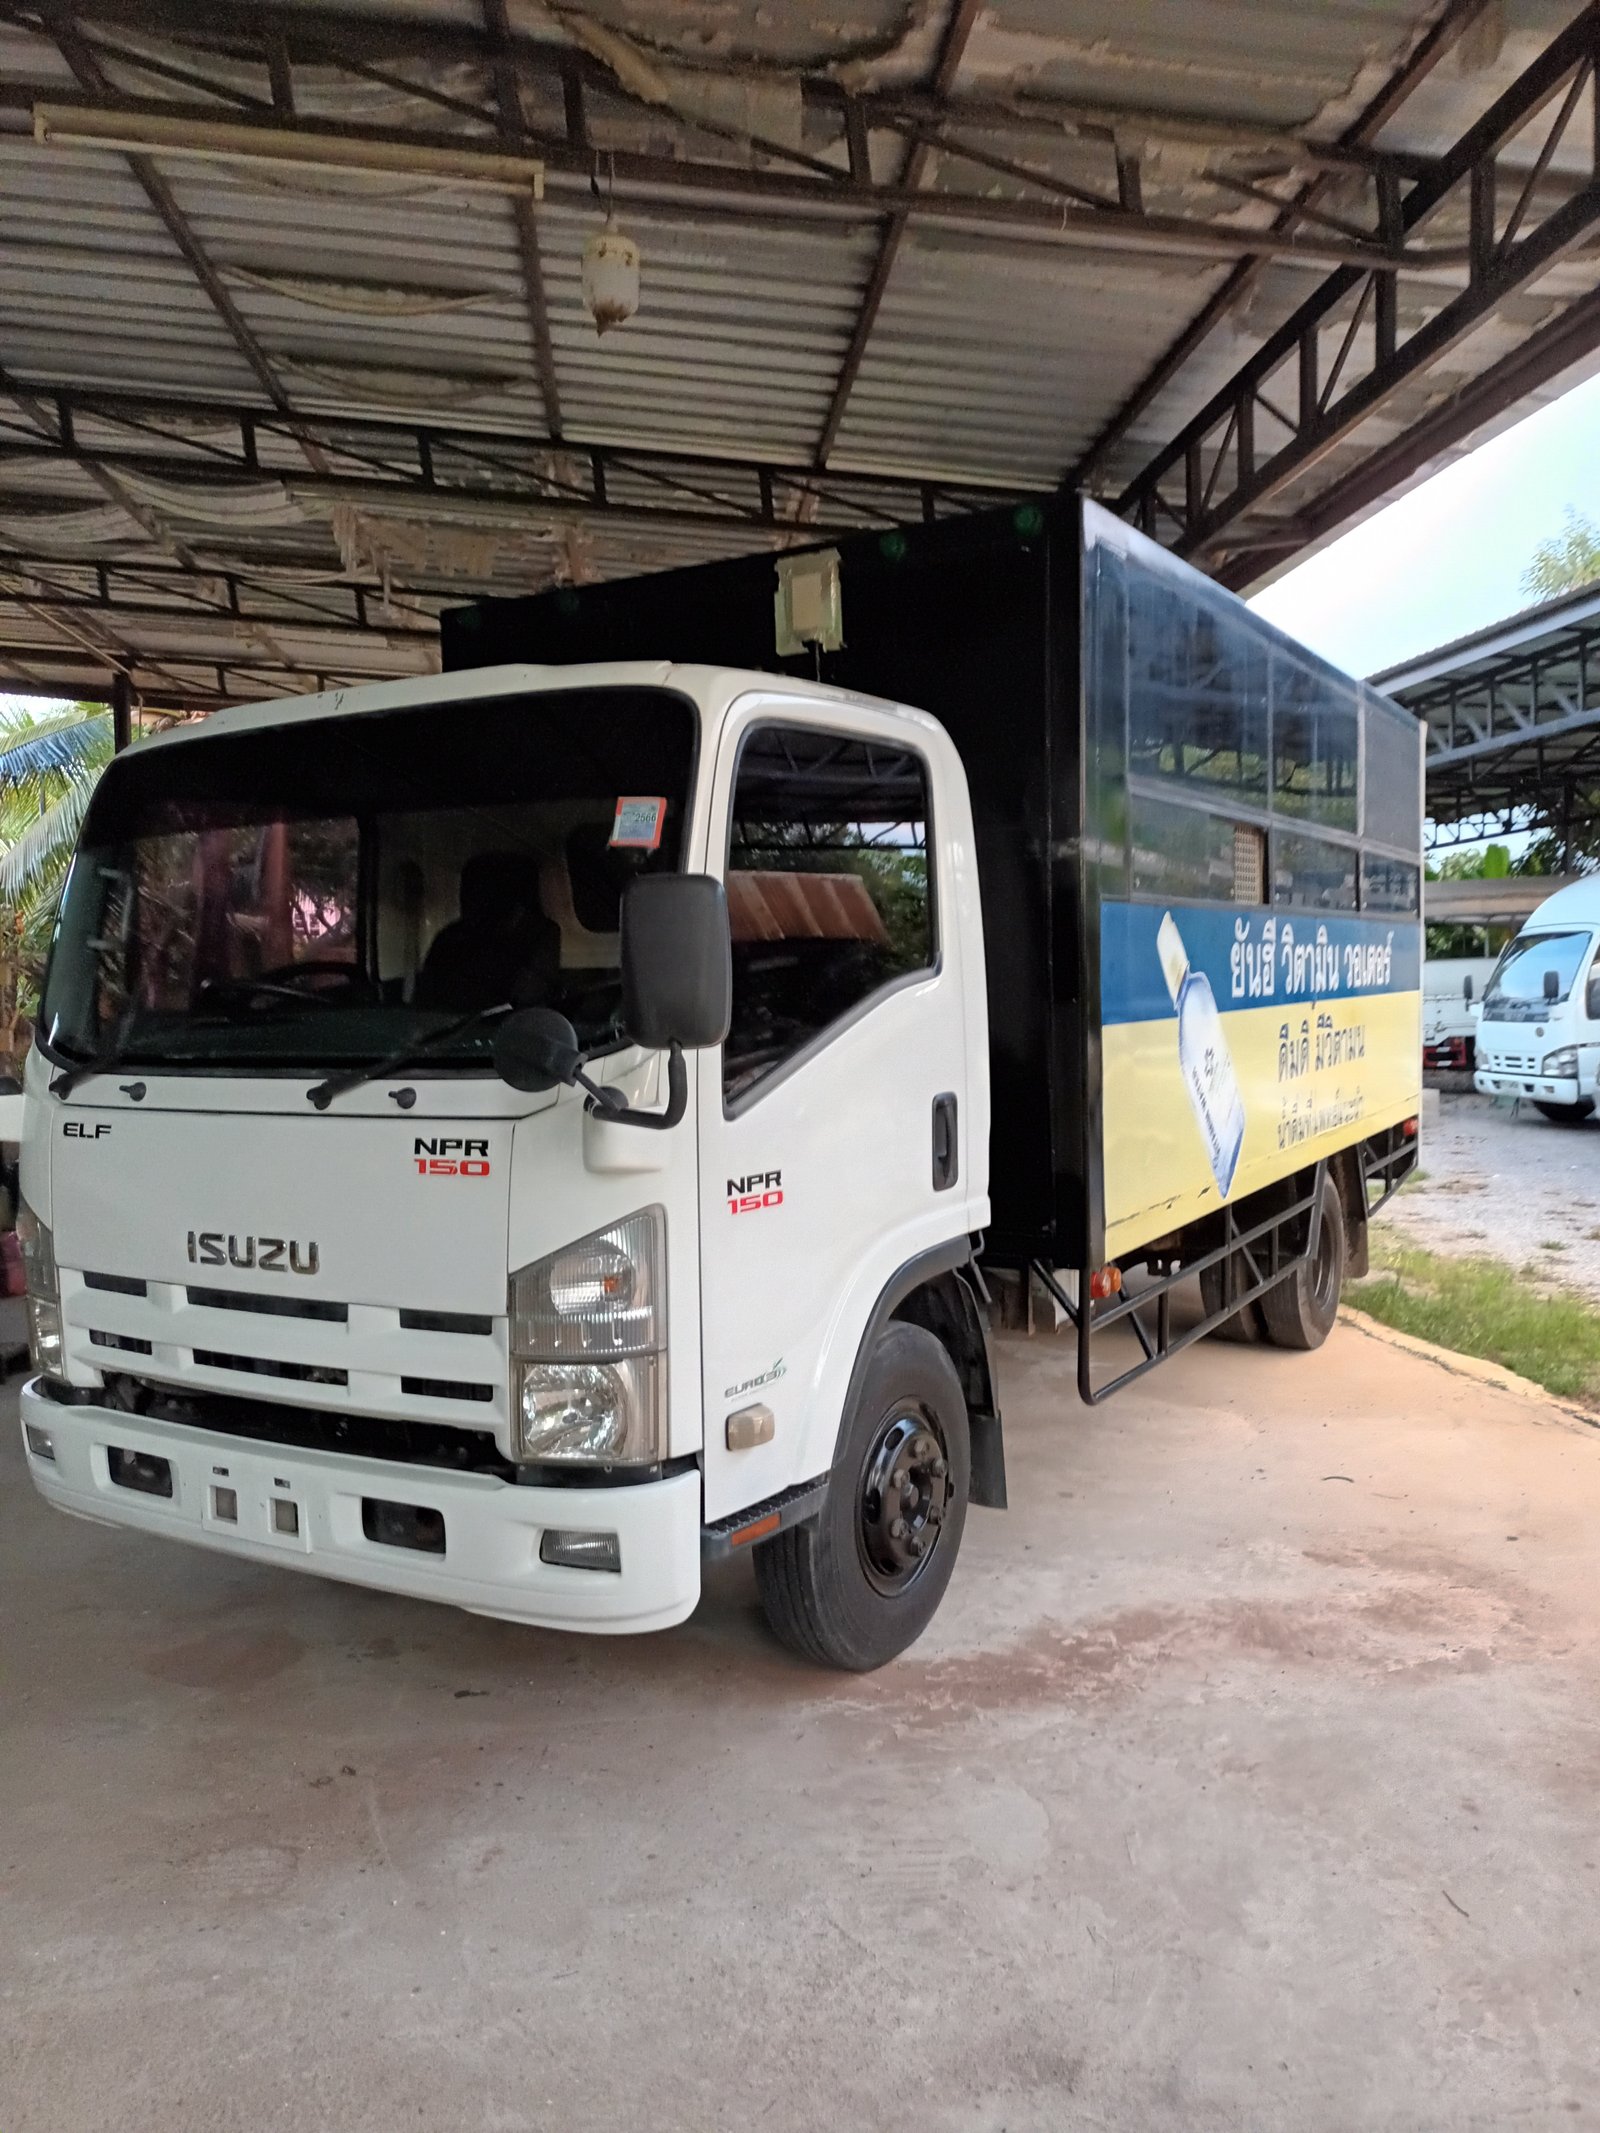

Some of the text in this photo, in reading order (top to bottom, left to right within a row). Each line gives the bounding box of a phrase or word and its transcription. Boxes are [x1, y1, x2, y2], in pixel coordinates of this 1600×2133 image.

[1281, 923, 1339, 995] วิตามิน
[1344, 930, 1394, 989] วอเตอร์
[63, 1122, 112, 1139] ELF
[413, 1137, 489, 1157] NPR
[413, 1158, 490, 1176] 150
[727, 1169, 782, 1196] NPR
[727, 1190, 784, 1215] 150
[187, 1230, 320, 1275] ISUZU
